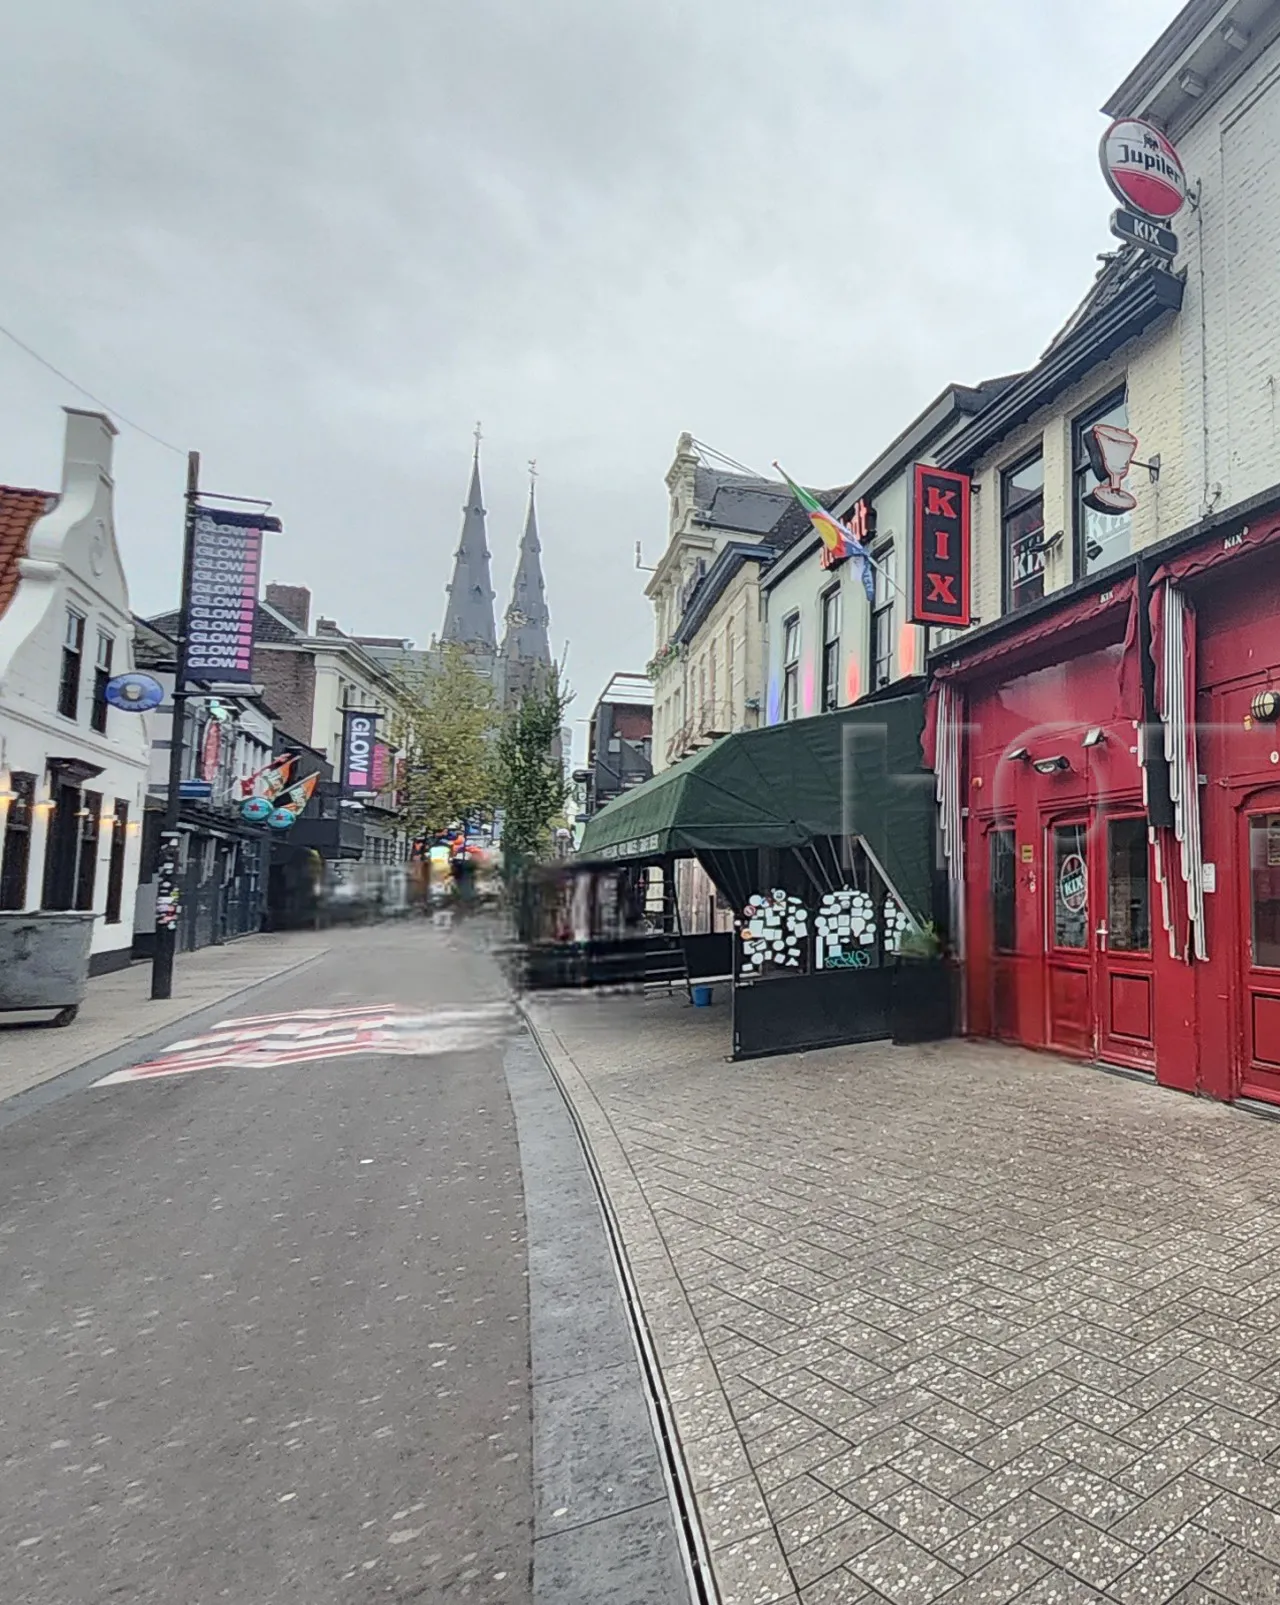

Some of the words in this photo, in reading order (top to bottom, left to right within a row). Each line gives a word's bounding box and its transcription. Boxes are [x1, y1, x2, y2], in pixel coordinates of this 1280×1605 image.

[1116, 144, 1181, 184] Jupiler
[1133, 218, 1160, 246] KIX
[199, 521, 247, 536] GLOW
[198, 533, 246, 548] GLOW
[927, 486, 957, 604] KIX
[1224, 533, 1243, 550] KIX
[196, 546, 245, 559] GLOW
[195, 558, 244, 571] GLOW
[194, 570, 243, 584] GLOW
[193, 583, 242, 596] GLOW
[191, 595, 241, 608] GLOW
[190, 607, 240, 620] GLOW
[190, 619, 239, 632] GLOW
[189, 632, 238, 644] GLOW
[188, 645, 237, 656] GLOW
[187, 657, 236, 668] GLOW
[349, 717, 371, 772] GLOW
[1064, 875, 1084, 896] KIX
